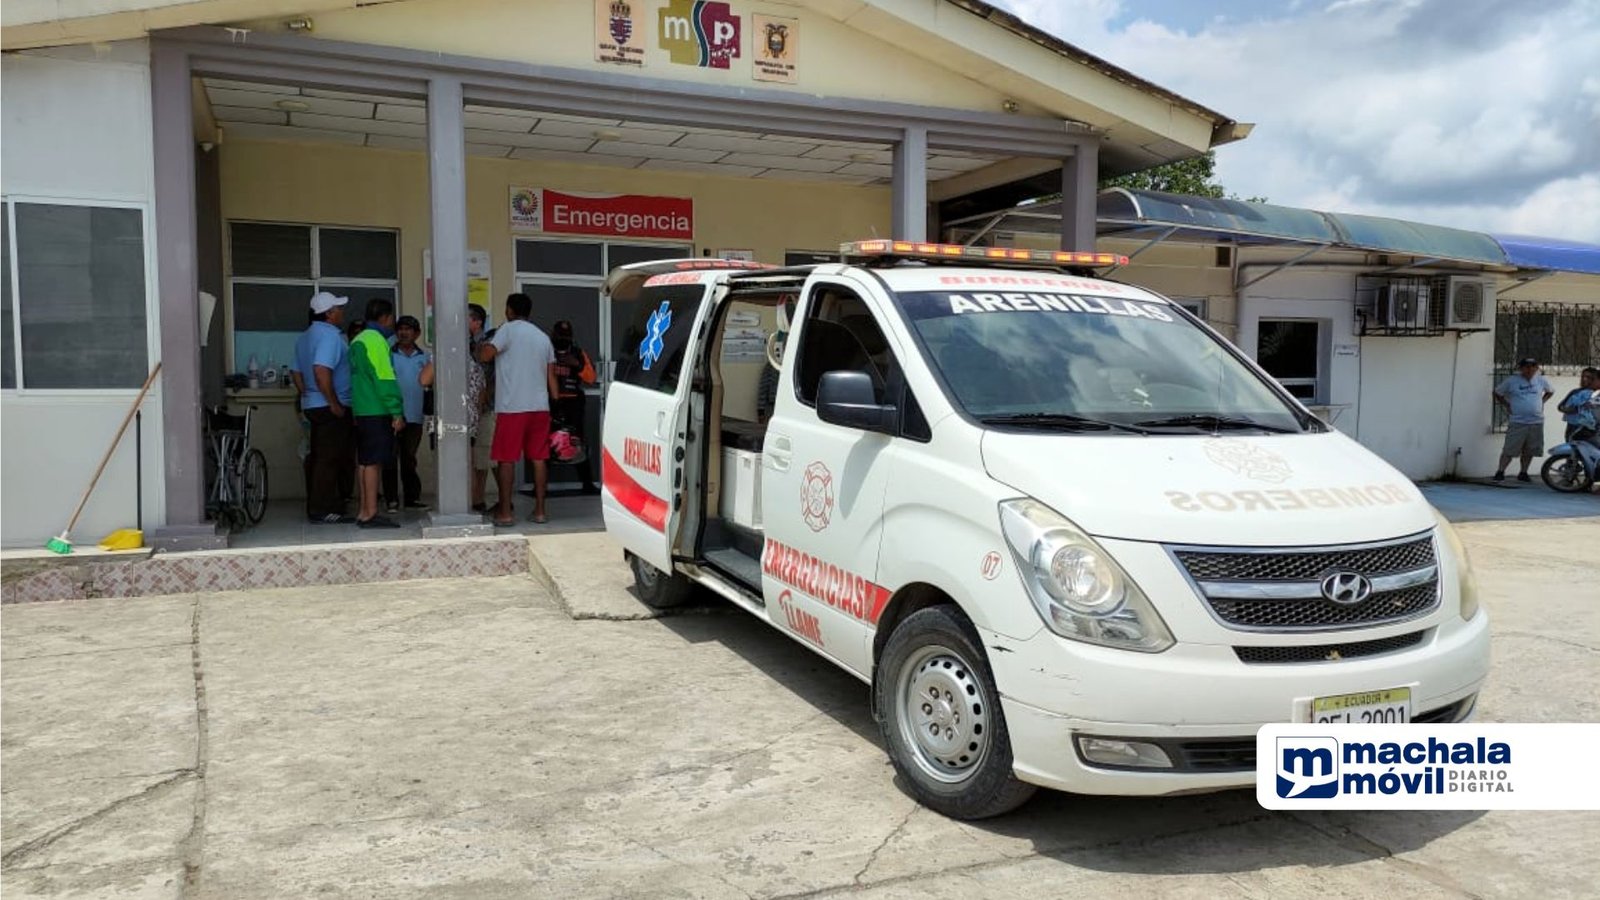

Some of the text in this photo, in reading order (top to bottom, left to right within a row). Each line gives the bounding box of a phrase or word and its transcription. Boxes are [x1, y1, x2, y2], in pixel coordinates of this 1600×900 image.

[553, 204, 689, 232] Emergencia
[939, 275, 1121, 293] BOMBEROS
[949, 292, 1174, 322] ARENILLAS
[624, 436, 661, 477] ARENILLAS
[764, 538, 864, 618] EMERGENCIAS
[984, 555, 1000, 576] 07
[784, 600, 824, 647] LLAME
[1344, 693, 1381, 707] ECUADOR
